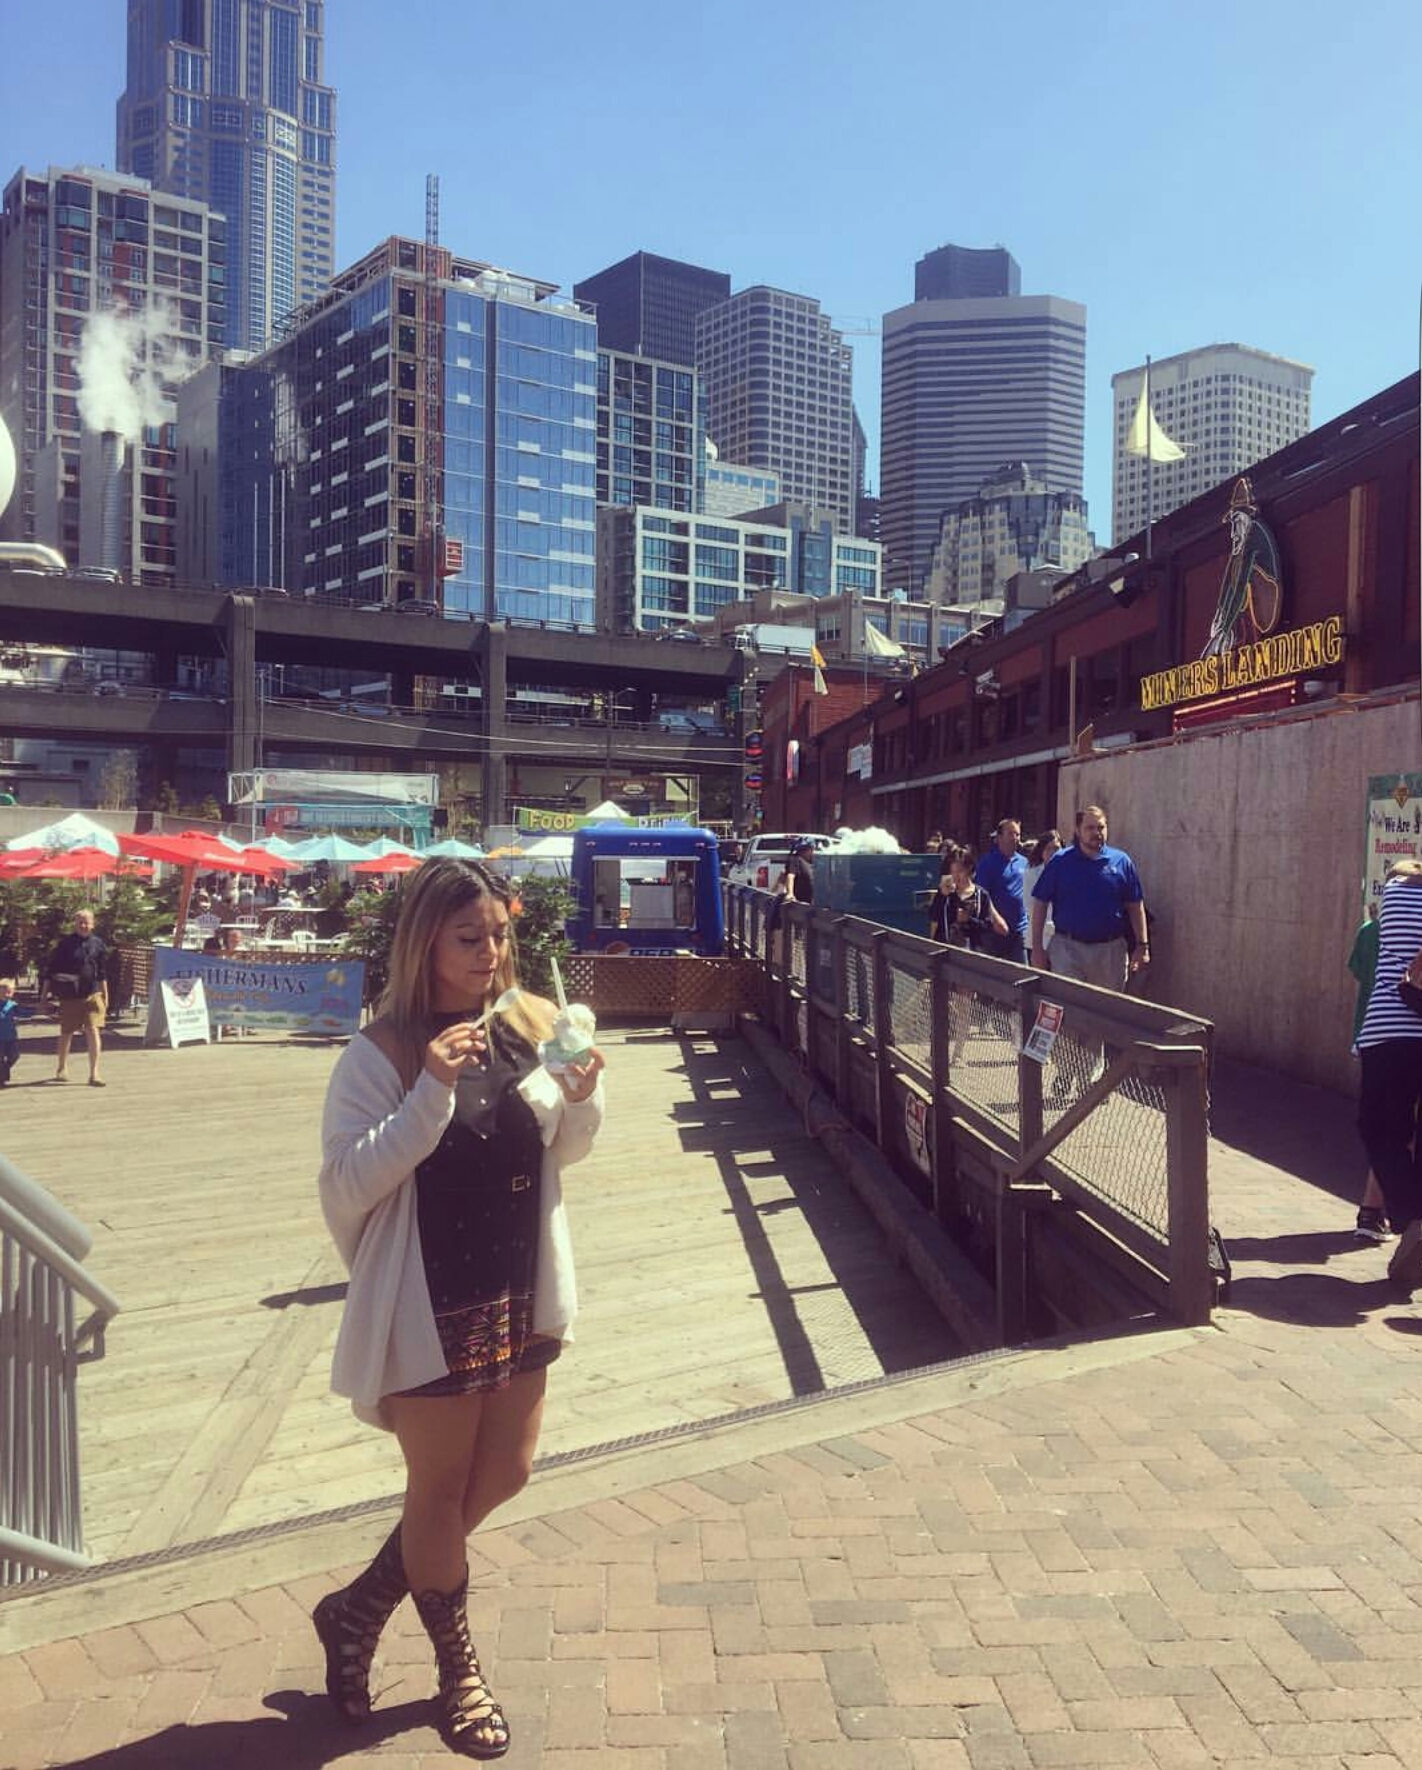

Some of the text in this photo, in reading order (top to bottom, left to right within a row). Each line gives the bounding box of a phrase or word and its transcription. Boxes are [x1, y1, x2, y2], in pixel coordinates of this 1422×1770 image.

[1140, 615, 1343, 712] MINERS LANDING
[1385, 816, 1396, 832] We
[1397, 815, 1411, 832] Are
[1374, 838, 1418, 857] Remodeling
